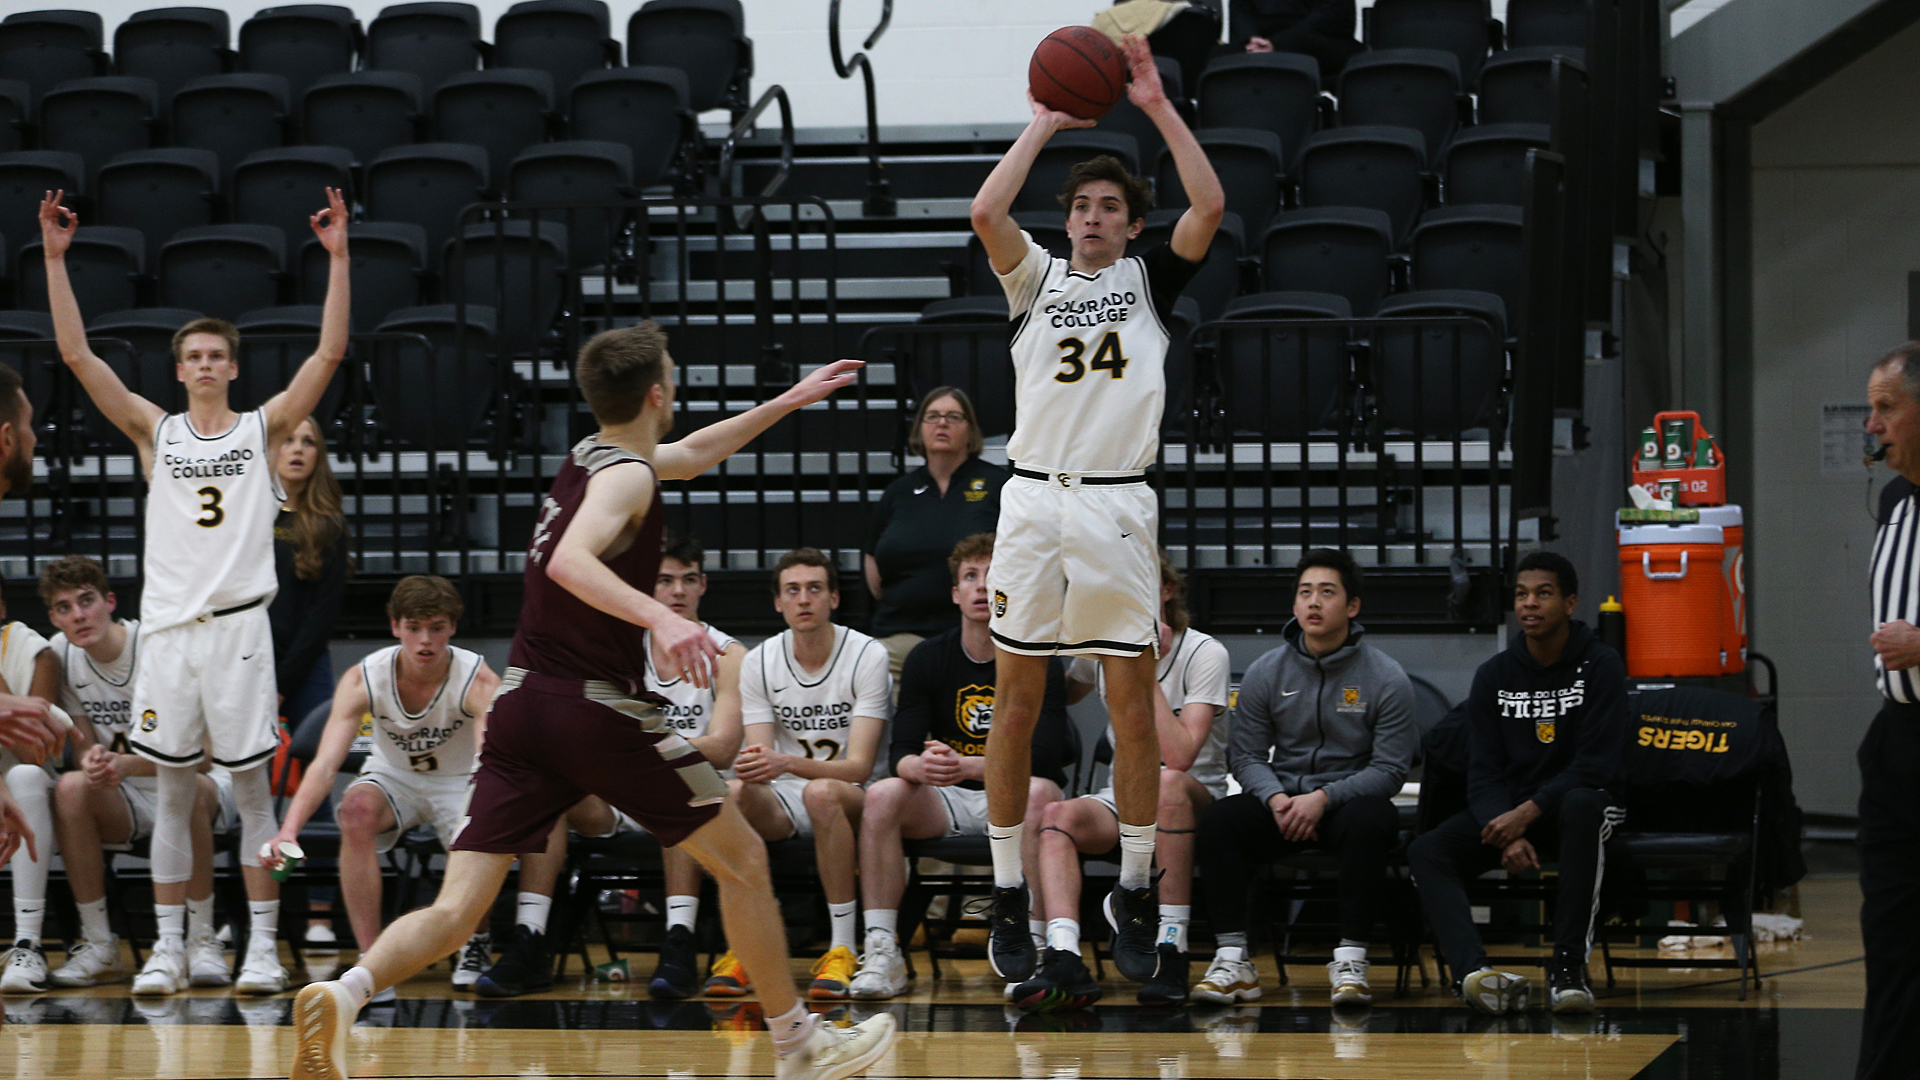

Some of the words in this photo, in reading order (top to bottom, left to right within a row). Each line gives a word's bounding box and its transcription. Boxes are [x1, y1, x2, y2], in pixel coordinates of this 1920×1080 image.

[1044, 291, 1136, 315] COLORADO
[1050, 307, 1129, 329] COLLEGE
[1053, 330, 1131, 385] 34
[172, 463, 246, 479] COLLEGE
[1691, 480, 1708, 493] 02
[195, 485, 226, 529] 3
[772, 702, 852, 718] COLORADO
[385, 720, 464, 742] OLORADO
[782, 716, 850, 731] COLLEGE
[1638, 726, 1730, 753] TIGERS
[408, 750, 440, 773] 5
